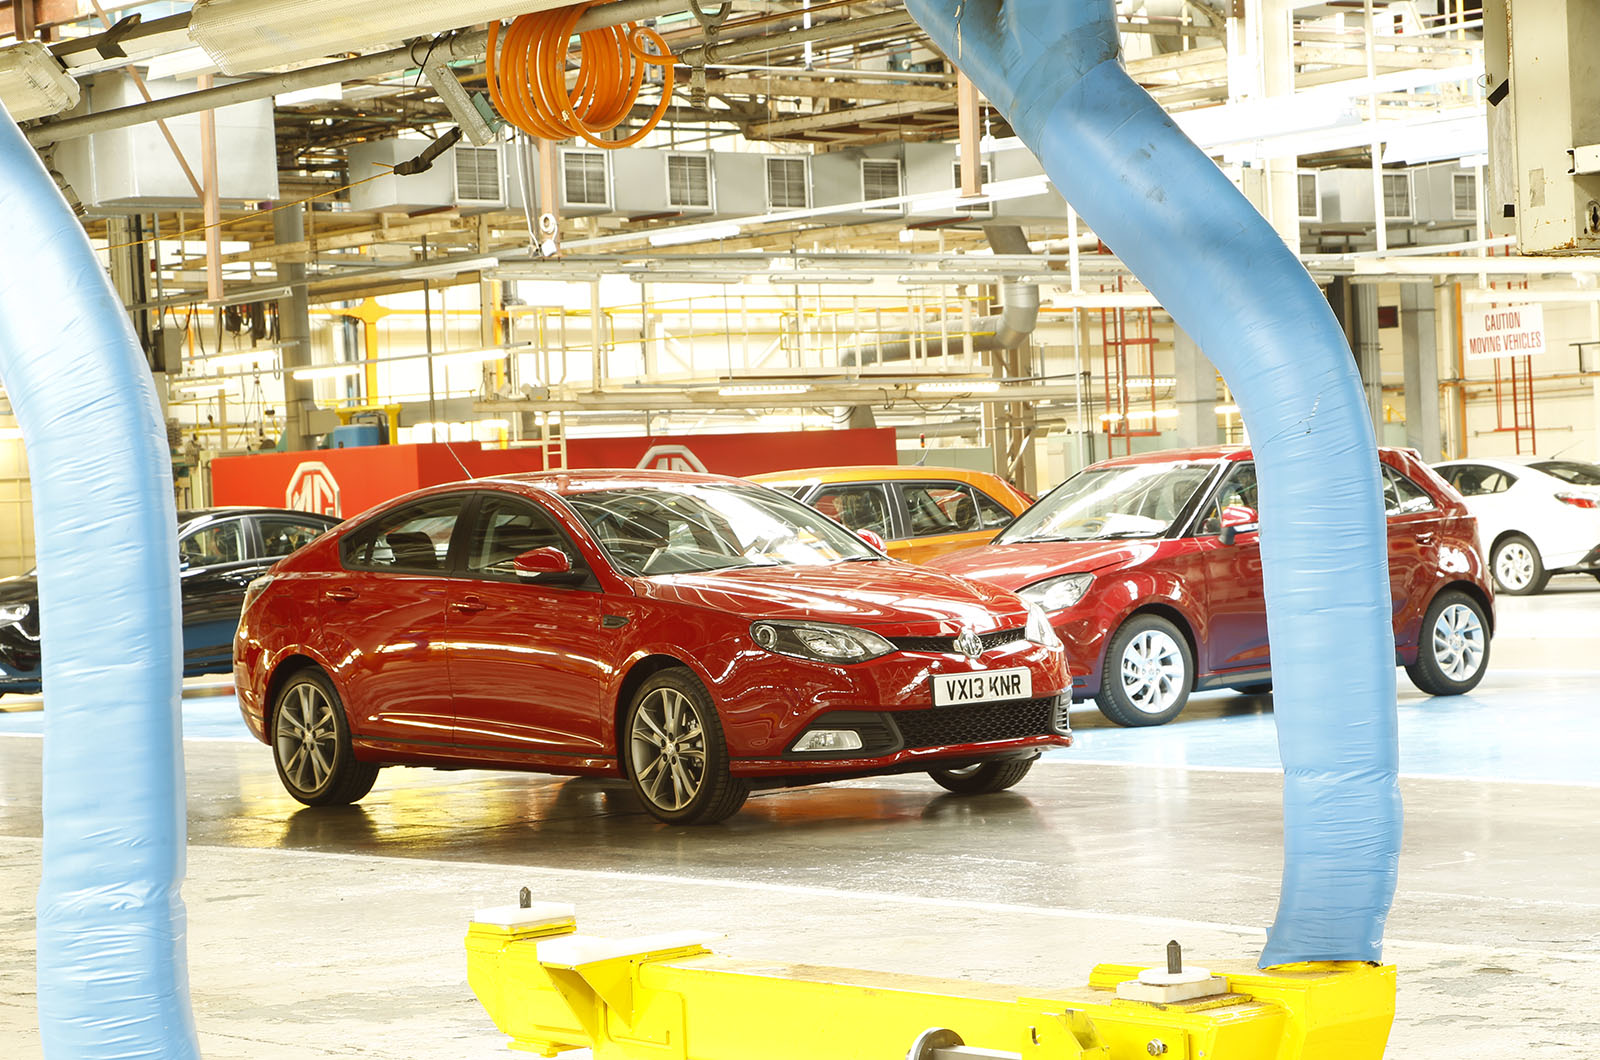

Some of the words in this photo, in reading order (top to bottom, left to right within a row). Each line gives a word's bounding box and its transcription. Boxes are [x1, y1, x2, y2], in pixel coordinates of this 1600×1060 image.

[1485, 312, 1521, 331] CAUTION
[1469, 335, 1501, 355] MOVING
[1503, 331, 1541, 351] VEHICLES
[292, 473, 335, 516] MG
[946, 677, 984, 701] VX13
[989, 674, 1021, 696] KNR
